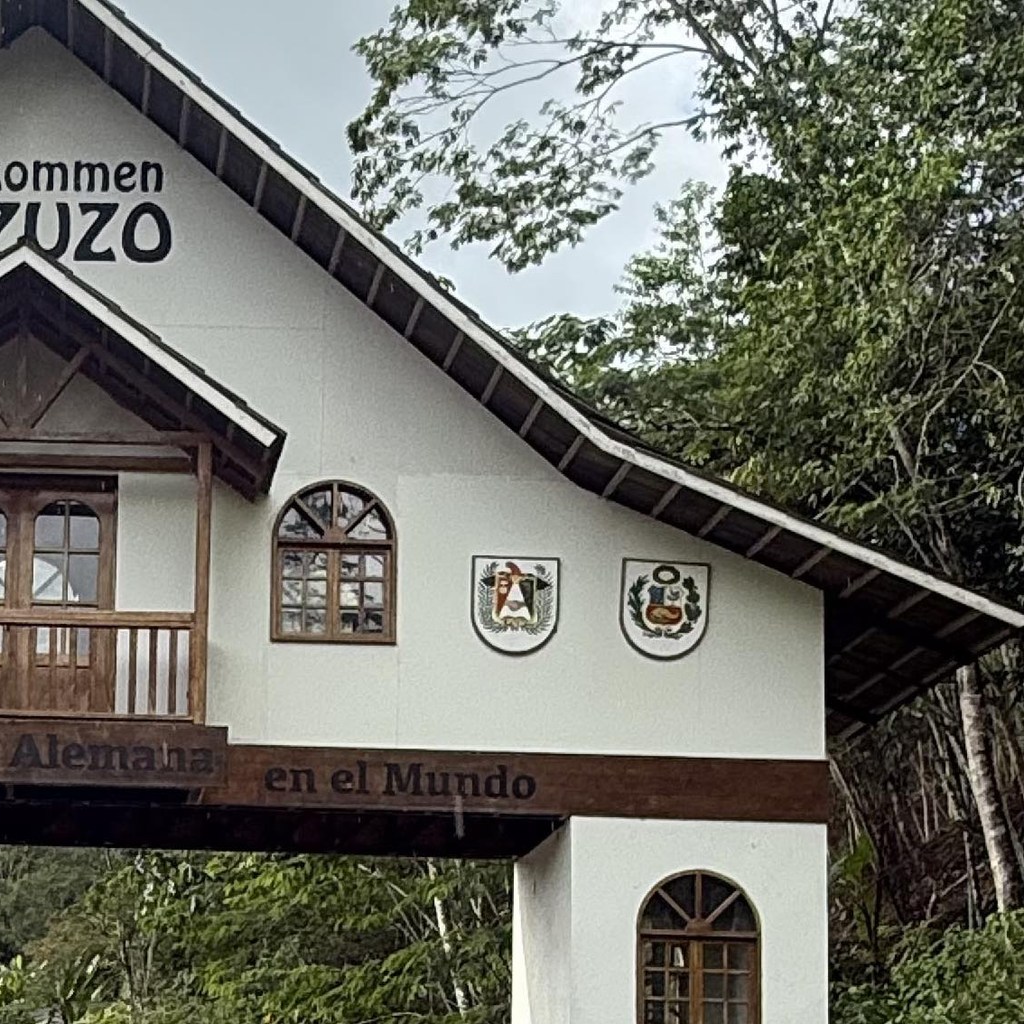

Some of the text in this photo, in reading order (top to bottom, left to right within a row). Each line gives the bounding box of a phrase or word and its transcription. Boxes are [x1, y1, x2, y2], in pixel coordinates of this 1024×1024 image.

[8, 733, 216, 774] Alemana
[264, 766, 317, 793] en
[330, 761, 370, 795] el
[382, 762, 537, 800] Mundo
